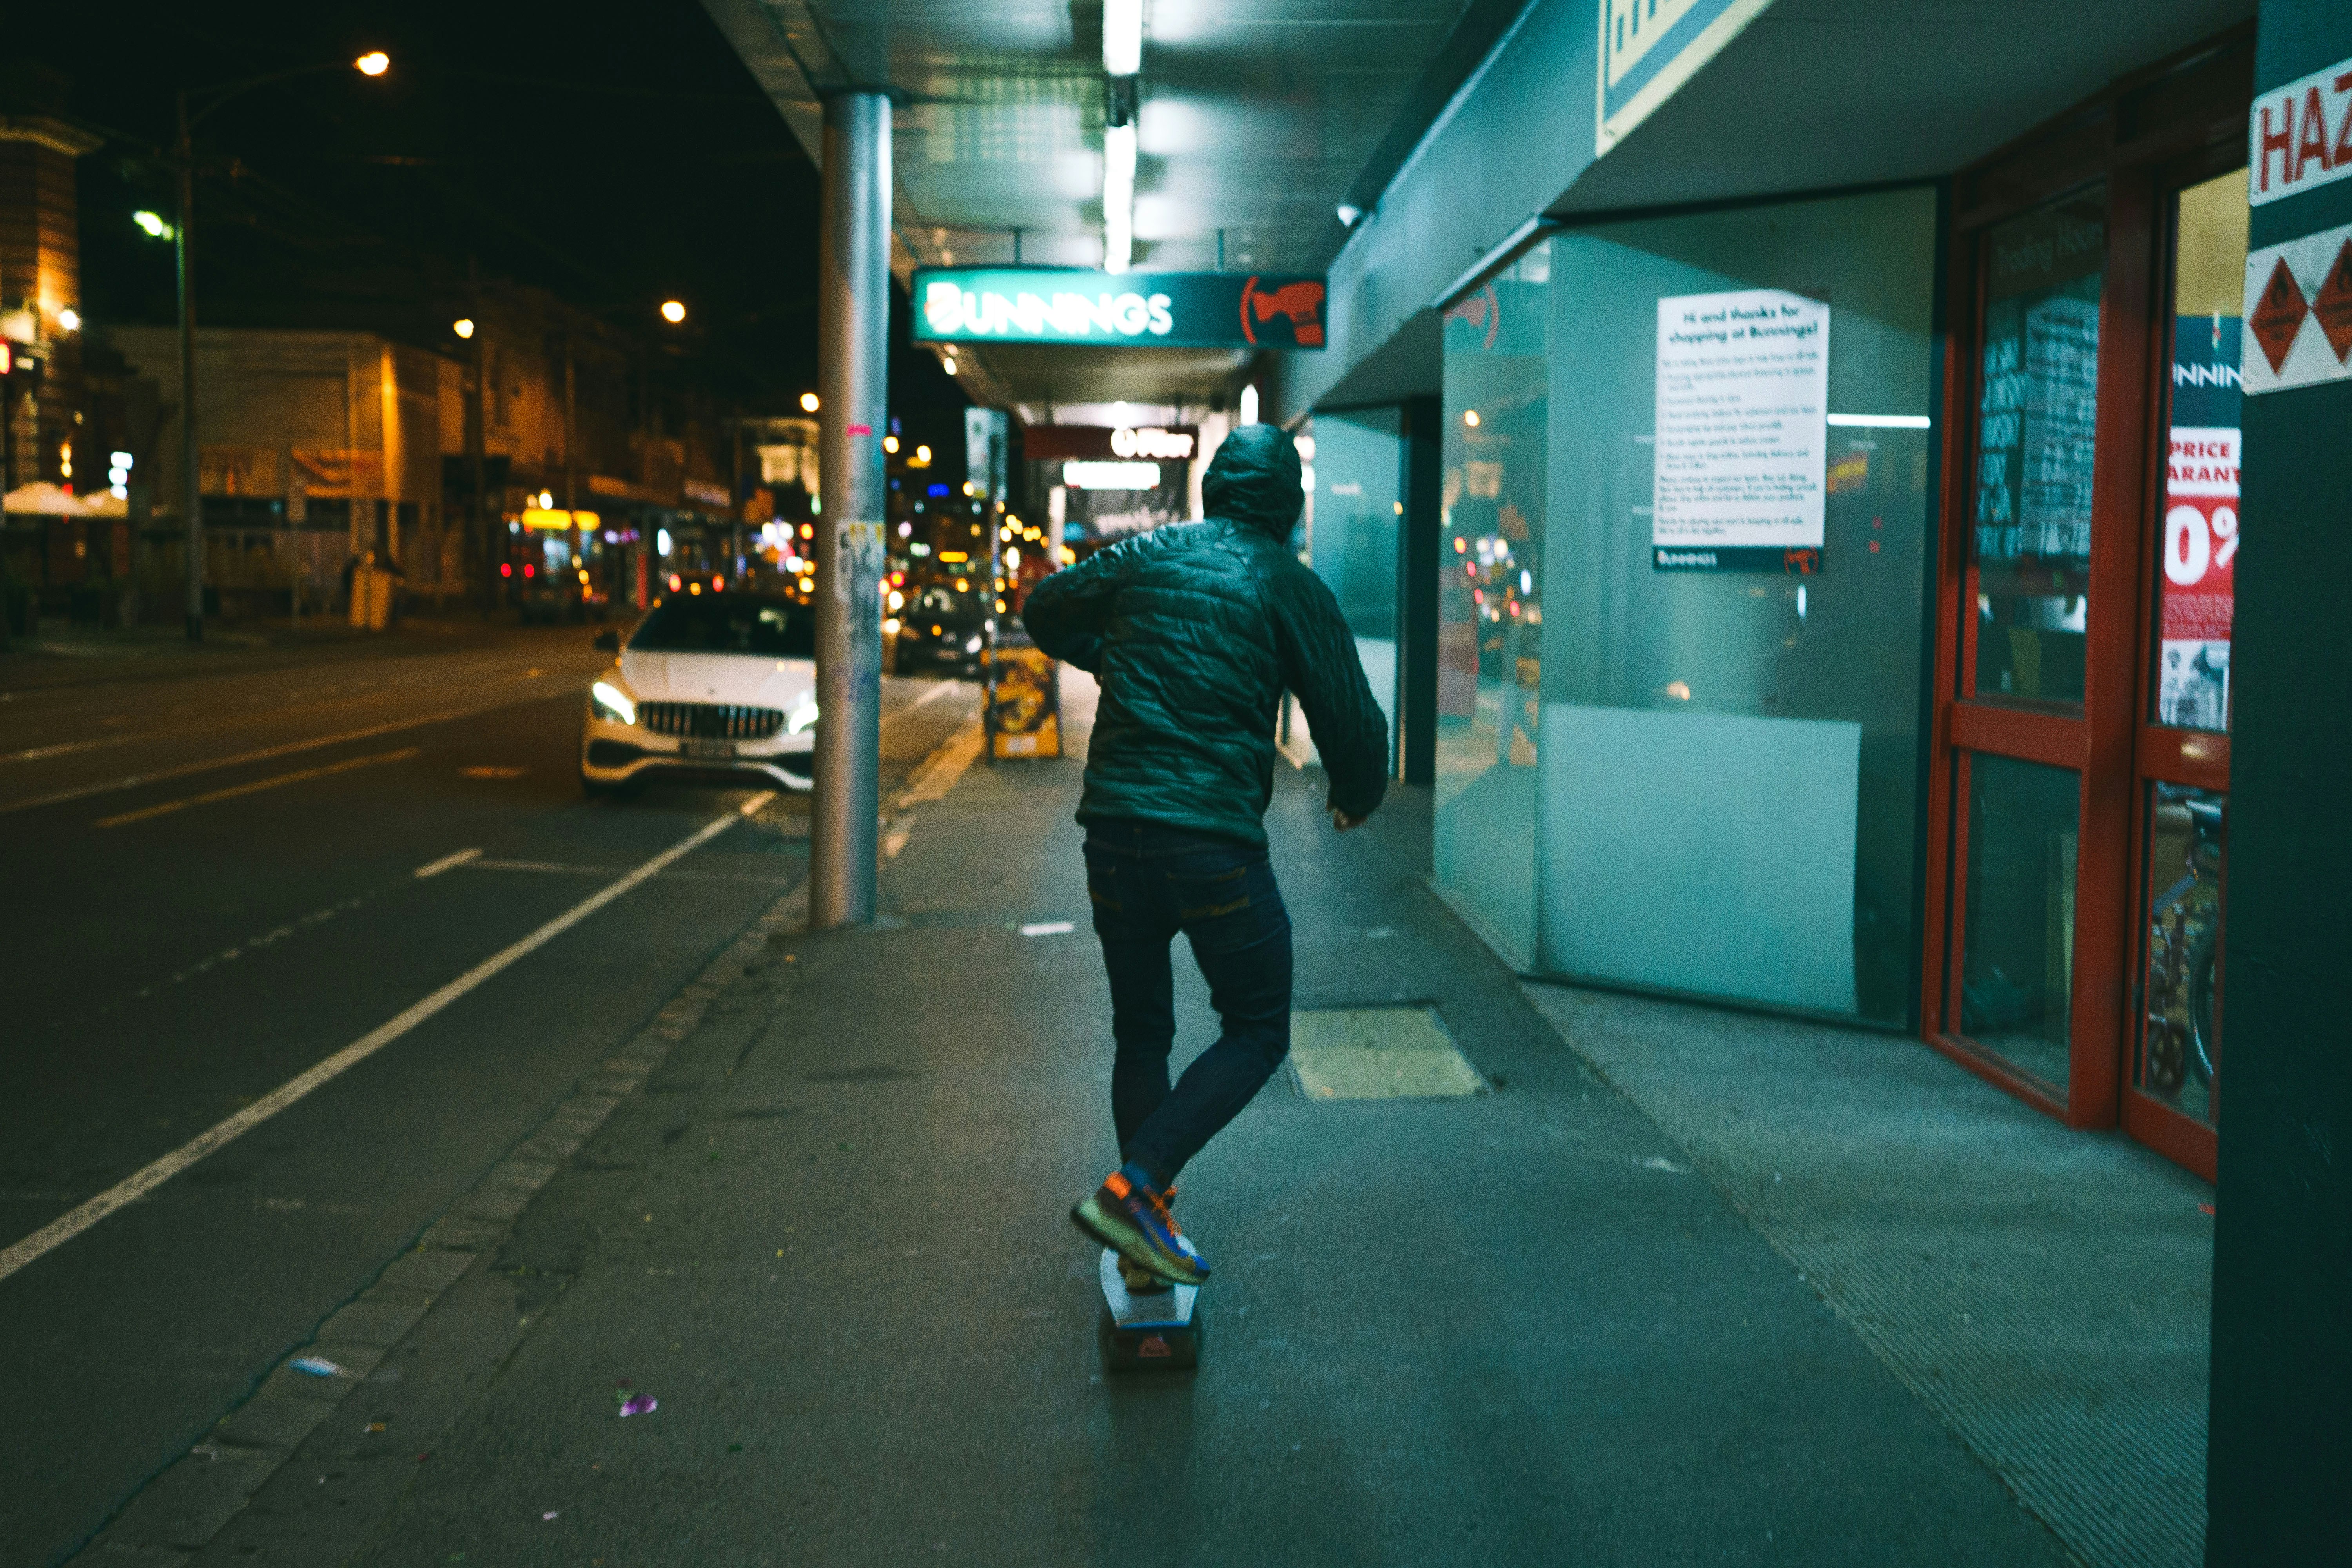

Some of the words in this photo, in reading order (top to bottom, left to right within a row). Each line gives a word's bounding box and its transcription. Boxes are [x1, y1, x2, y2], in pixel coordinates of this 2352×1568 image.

[926, 282, 1172, 336] BUNNINGS
[1684, 312, 1696, 323] Hi
[1701, 308, 1727, 323] and
[1730, 304, 1776, 320] thanks
[1780, 302, 1800, 318] for
[1669, 329, 1727, 344] shopping
[1732, 328, 1744, 338] at
[2168, 441, 2230, 457] PRICE
